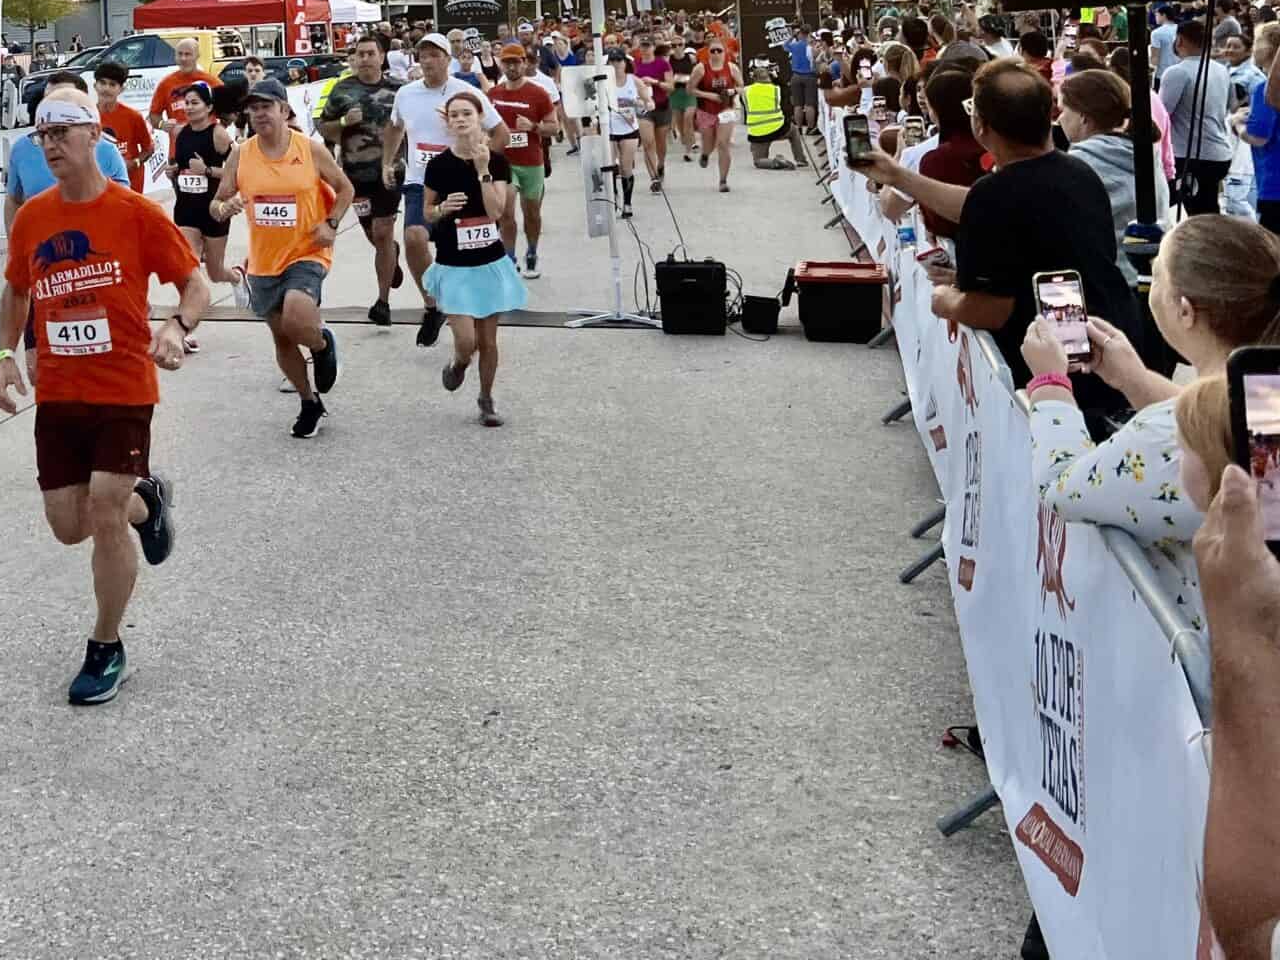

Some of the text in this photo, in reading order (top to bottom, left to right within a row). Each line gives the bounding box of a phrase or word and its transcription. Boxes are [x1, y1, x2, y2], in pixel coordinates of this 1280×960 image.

[294, 11, 312, 54] AID
[183, 176, 202, 187] 173
[261, 205, 289, 218] 446
[465, 227, 491, 240] 178
[49, 261, 113, 285] ARMADILLO
[51, 281, 74, 297] RUN
[57, 324, 97, 342] 410
[1033, 626, 1076, 727] 10 FOR
[1039, 710, 1079, 825] TEXAS
